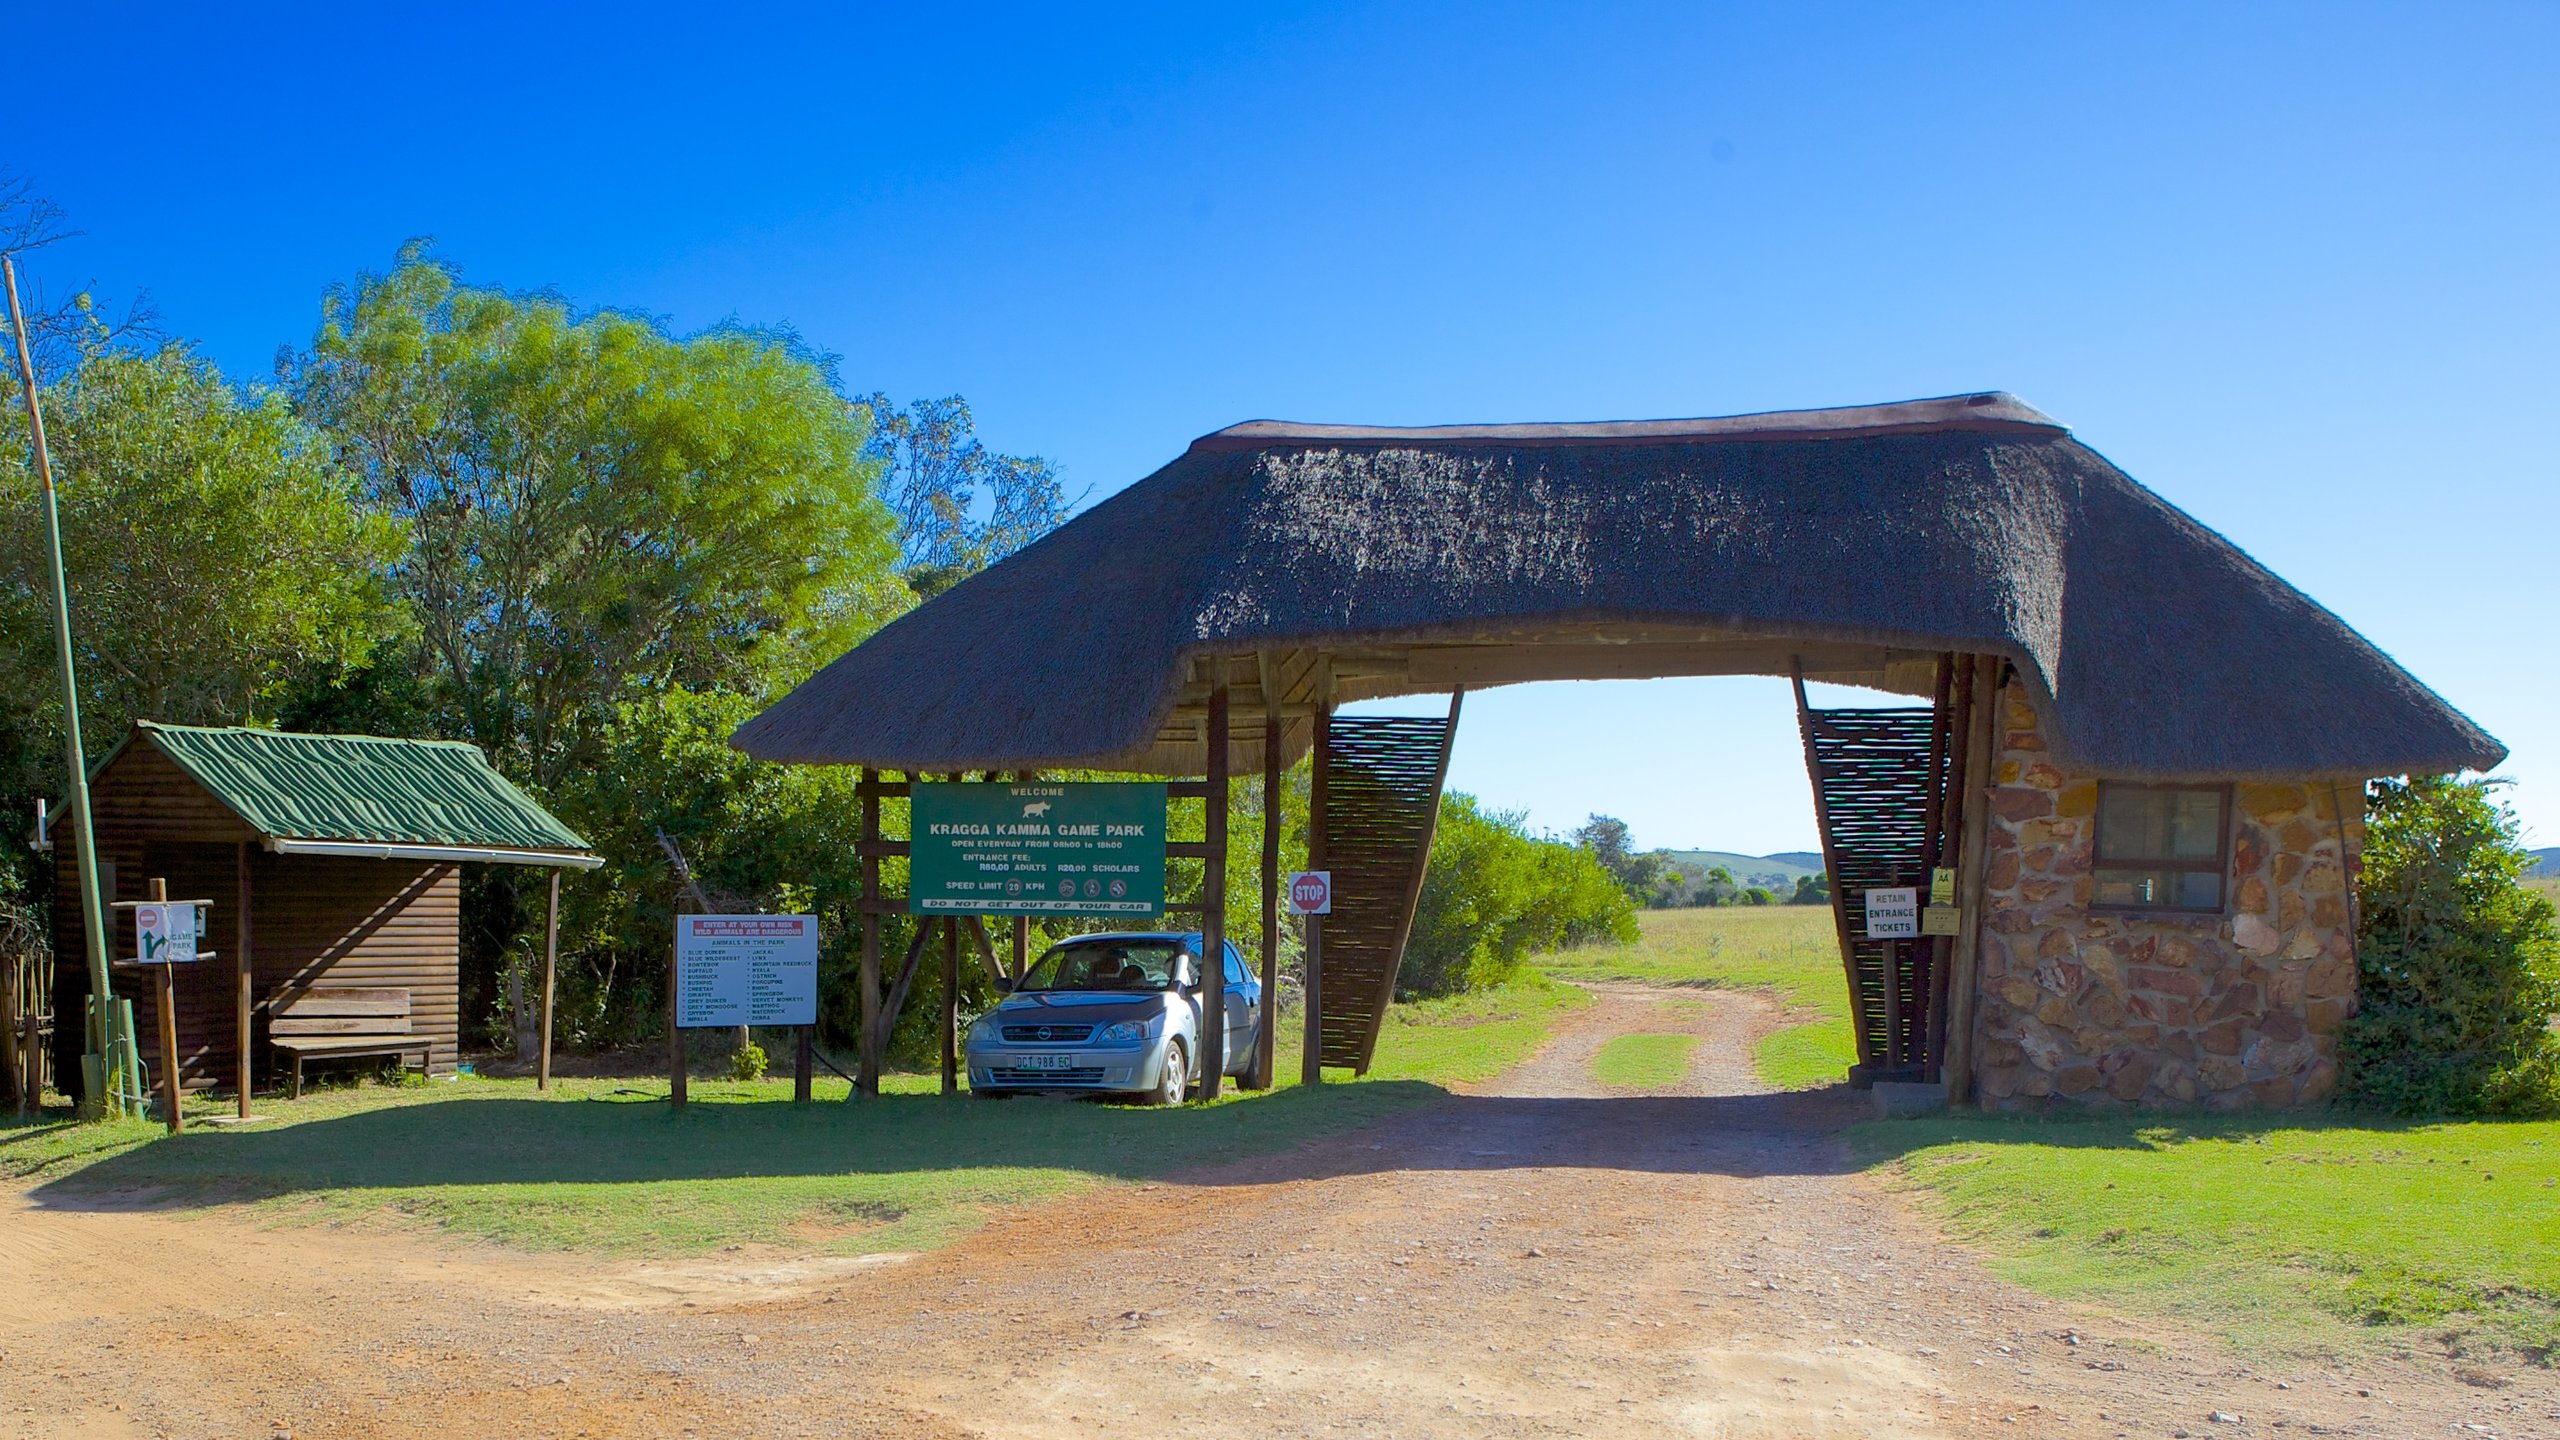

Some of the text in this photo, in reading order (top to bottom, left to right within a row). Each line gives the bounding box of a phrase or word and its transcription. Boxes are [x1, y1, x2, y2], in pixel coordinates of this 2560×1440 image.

[1011, 788, 1064, 796] WELCOME
[930, 824, 1145, 836] KRAGGA KAMMA GAME PARK
[951, 840, 975, 848] OPEN
[977, 840, 1022, 848] EVERYDAY
[1084, 841, 1093, 849] to
[1014, 864, 1047, 872] ADULTS
[1092, 864, 1140, 873] SCHOLARS
[946, 882, 975, 890] SPEED
[979, 882, 1003, 890] LIMIT
[1025, 883, 1045, 891] KPH
[1295, 885, 1324, 901] STOP
[1876, 894, 1906, 904] RETAIN
[1078, 902, 1111, 910] YOUR
[1869, 909, 1914, 918] ENTRANCE
[1874, 923, 1911, 932] TICKETS
[1037, 1056, 1054, 1068] 988
[1058, 1056, 1070, 1068] EC
